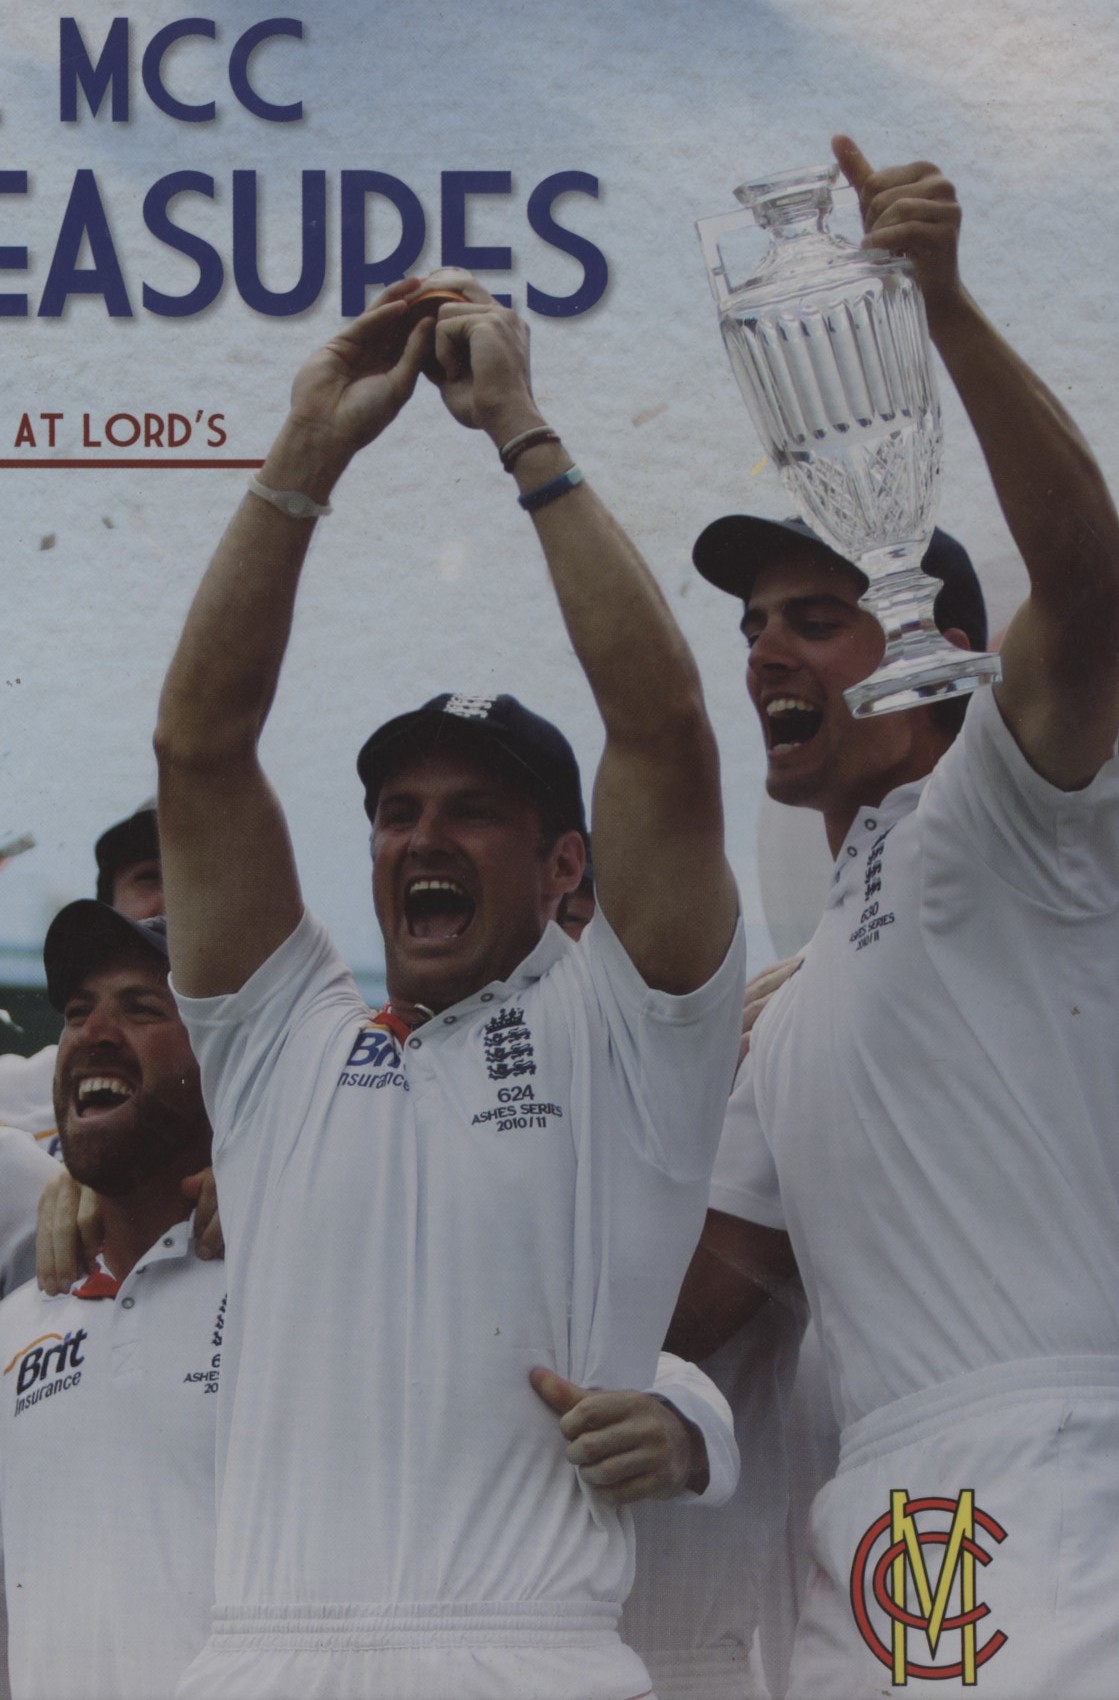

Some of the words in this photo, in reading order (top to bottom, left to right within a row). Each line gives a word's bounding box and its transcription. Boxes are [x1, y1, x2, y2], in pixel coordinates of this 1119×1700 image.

[59, 17, 304, 122] MCC
[14, 412, 64, 448] AT
[83, 409, 227, 448] LORD'S
[337, 1071, 411, 1092] nsurance
[496, 1084, 535, 1103] 624
[471, 1104, 517, 1126] ASHES
[520, 1102, 563, 1118] SERIES
[16, 1328, 88, 1396] Brit
[211, 1353, 221, 1368] 6
[183, 1370, 220, 1383] ASHE
[204, 1382, 219, 1394] 20
